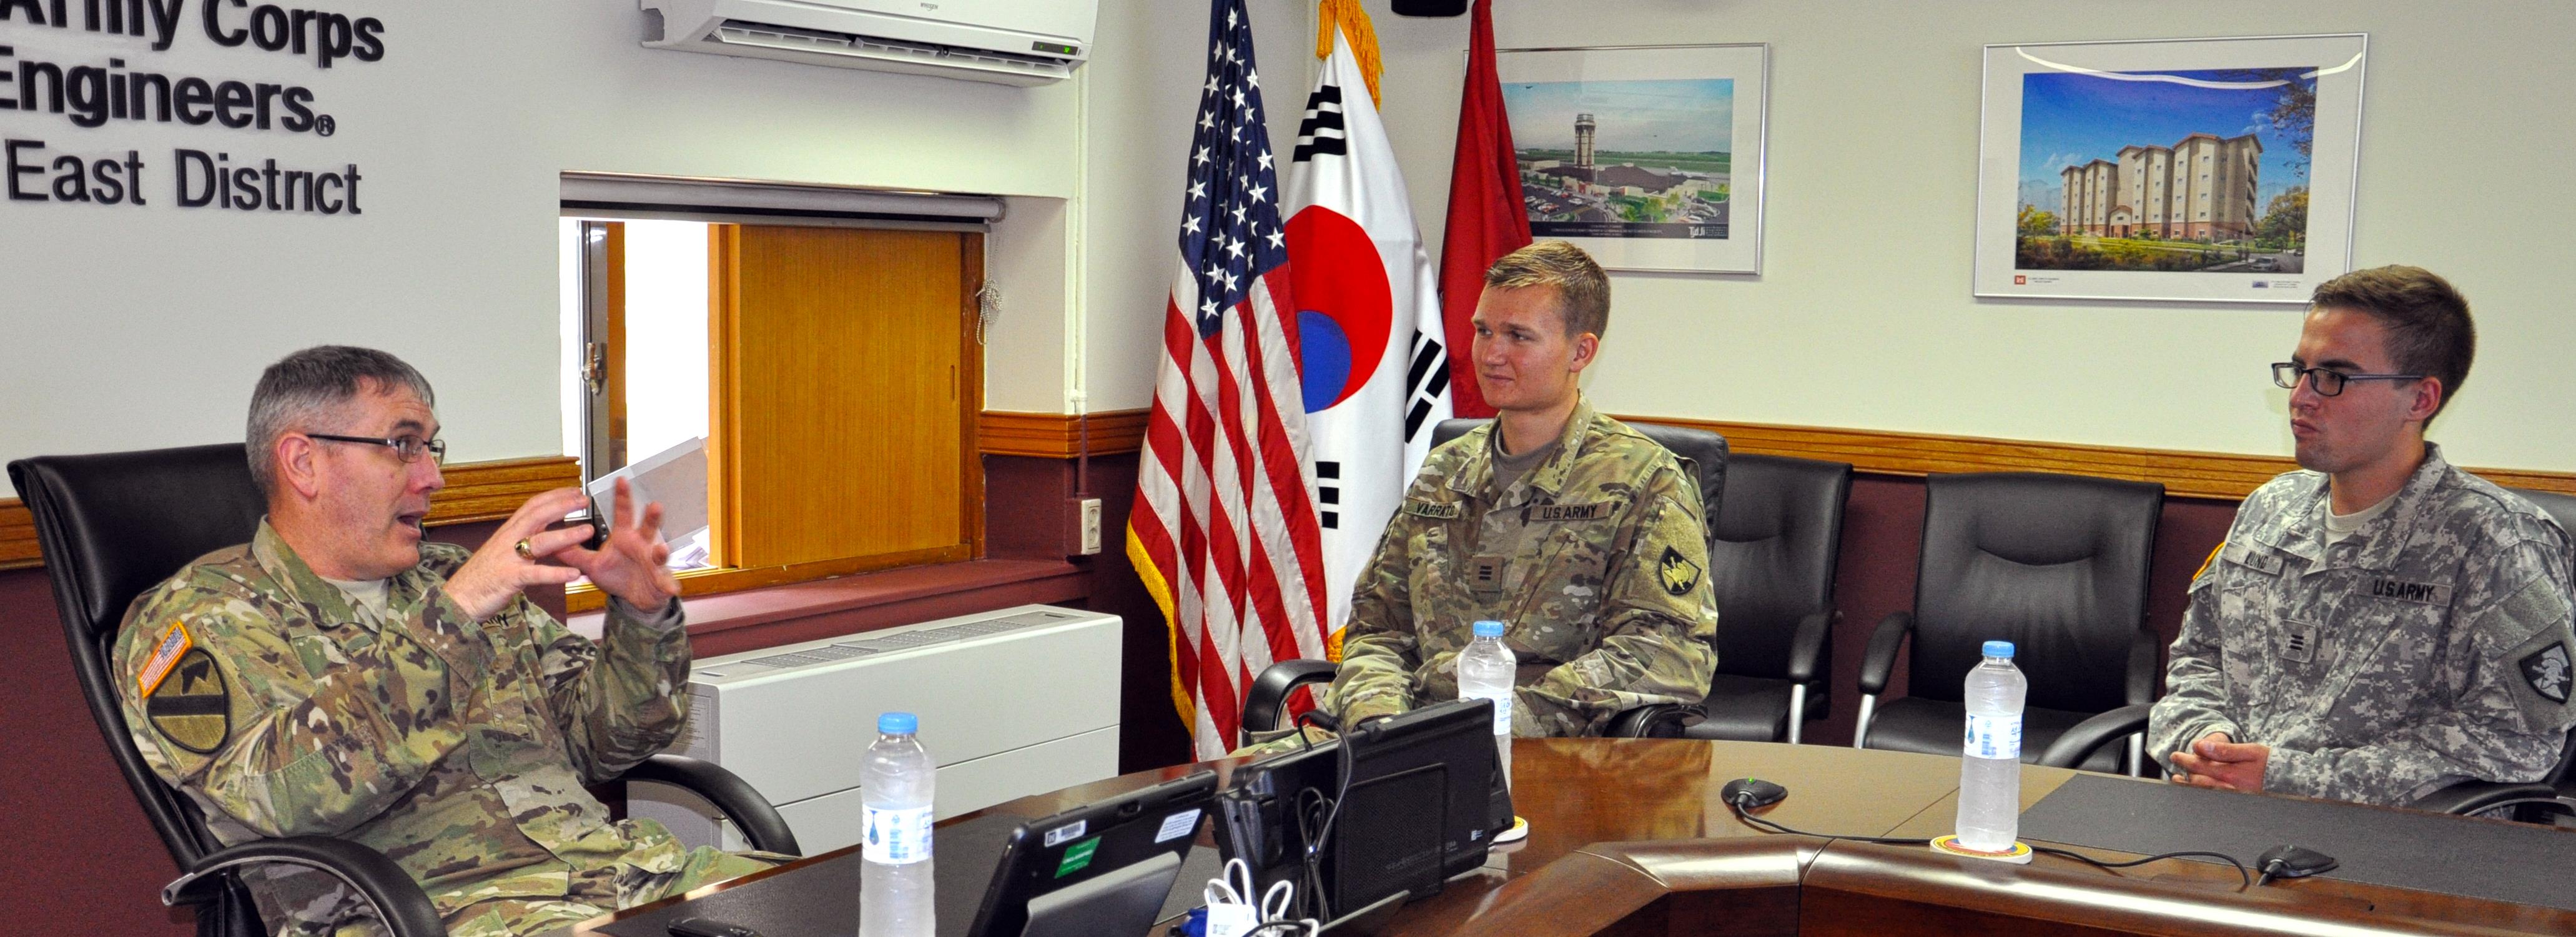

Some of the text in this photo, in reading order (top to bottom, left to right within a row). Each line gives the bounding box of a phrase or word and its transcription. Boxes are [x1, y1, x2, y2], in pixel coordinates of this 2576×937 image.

[202, 0, 385, 68] Corps
[5, 139, 362, 215] East District
[1562, 504, 1597, 519] ARMY
[2397, 582, 2435, 602] ARMY
